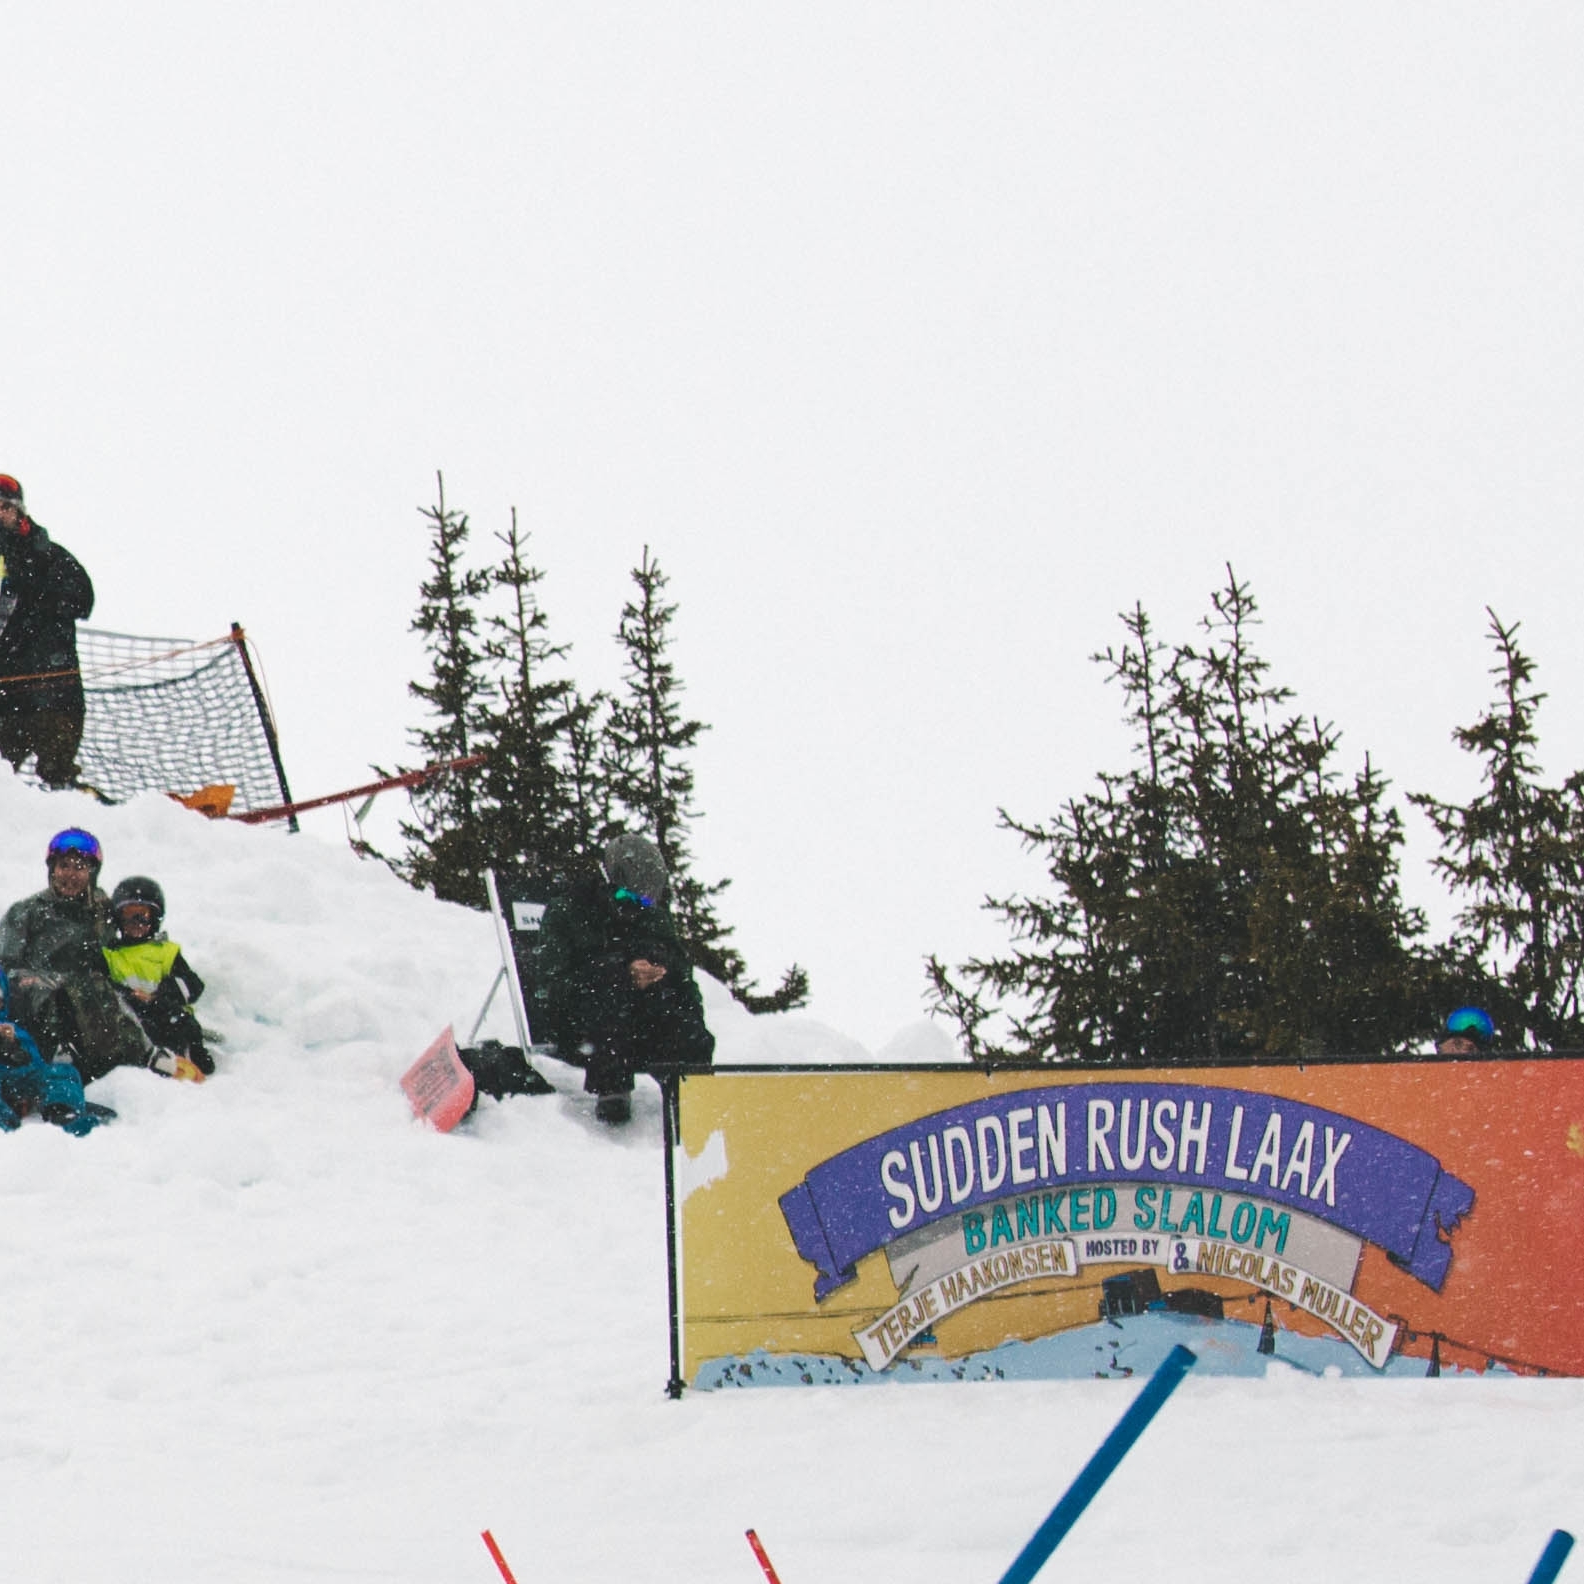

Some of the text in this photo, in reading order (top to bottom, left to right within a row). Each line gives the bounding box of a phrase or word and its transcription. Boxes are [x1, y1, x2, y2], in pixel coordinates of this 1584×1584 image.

[881, 1098, 1351, 1229] SUDDEN RUSH LAAX
[962, 1187, 1291, 1256] BANKED SLALOM
[1086, 1239, 1160, 1257] HOSTED BY
[867, 1243, 1068, 1357] TERJE HAAKONSEN
[1173, 1242, 1190, 1271] &
[1196, 1242, 1298, 1295] NICOLAS
